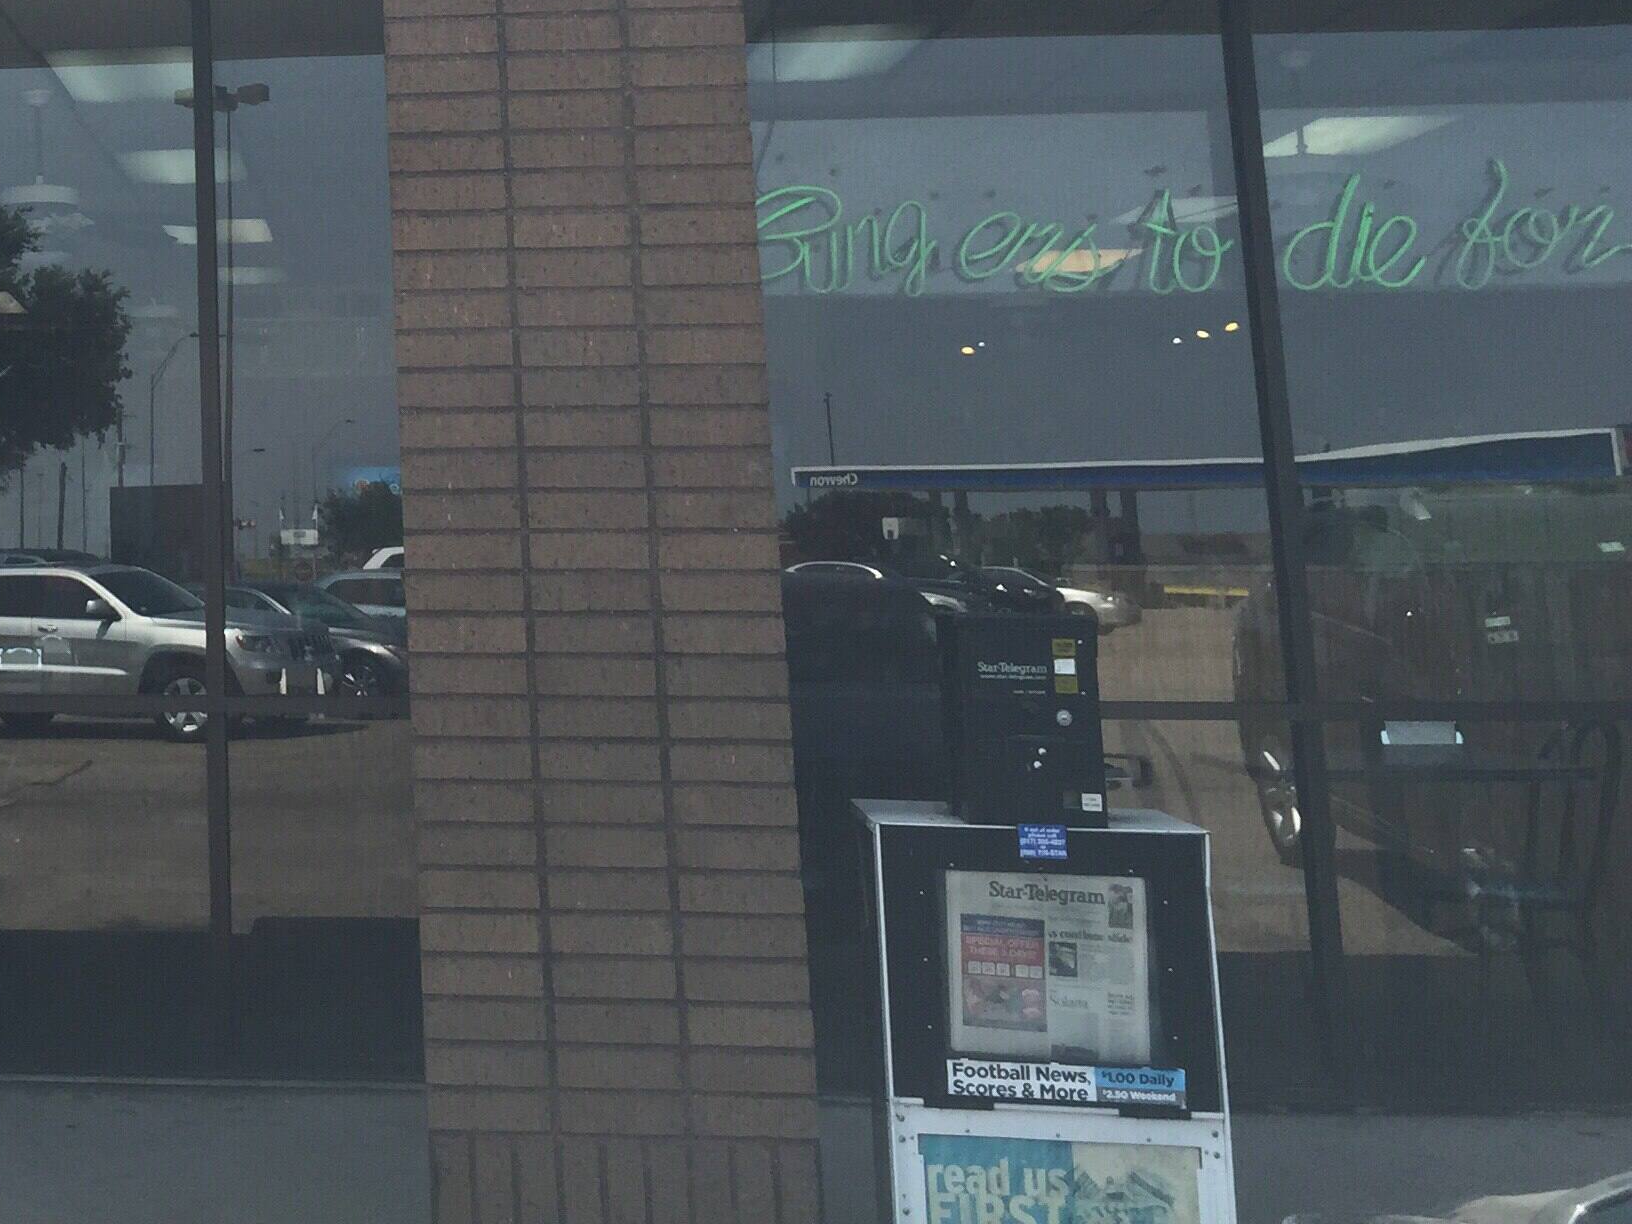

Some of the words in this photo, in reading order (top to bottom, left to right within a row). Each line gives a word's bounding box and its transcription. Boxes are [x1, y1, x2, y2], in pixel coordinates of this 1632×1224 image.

[1144, 189, 1234, 294] to
[1283, 172, 1428, 290] die
[988, 880, 1106, 906] Star-Telegram
[952, 1061, 1031, 1080] Football
[1035, 1066, 1092, 1086] News,
[1101, 1071, 1136, 1085] $1.00
[1139, 1074, 1175, 1088] Daily
[952, 1080, 1016, 1097] Scores
[1021, 1082, 1035, 1098] &
[1040, 1083, 1089, 1100] More
[1129, 1091, 1177, 1103] Weekend
[927, 1157, 1010, 1198] read
[1024, 1162, 1074, 1200] us
